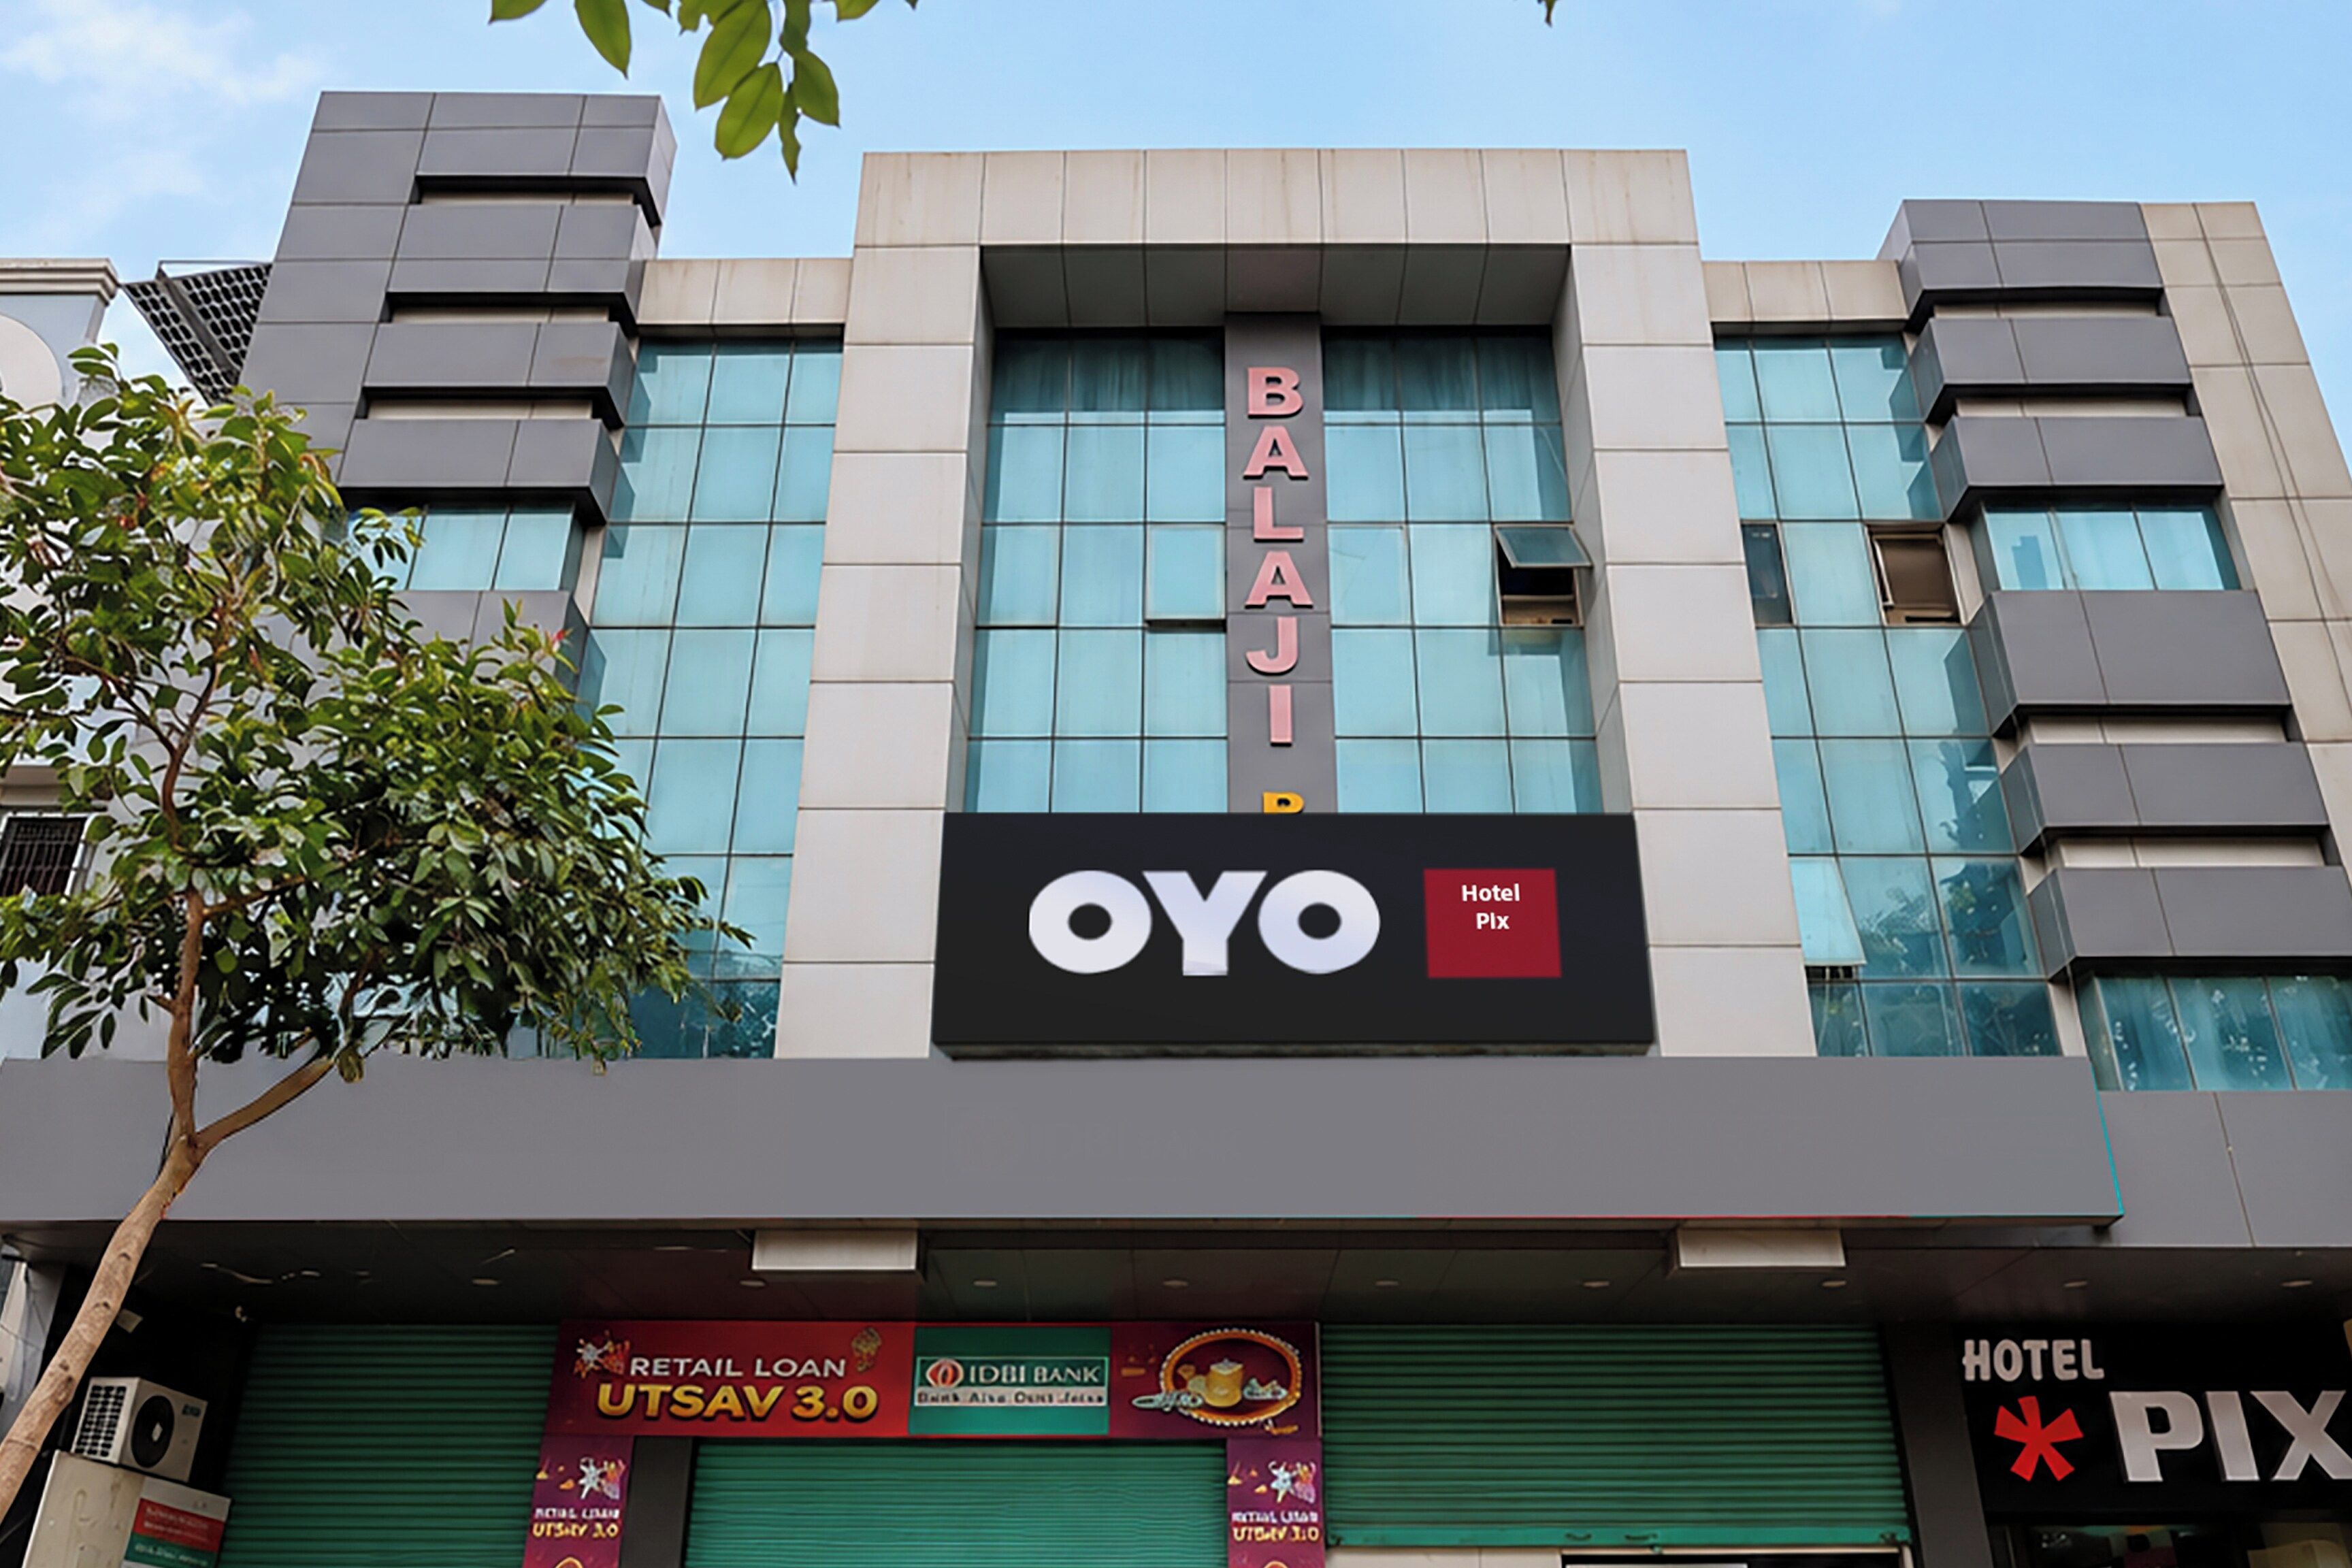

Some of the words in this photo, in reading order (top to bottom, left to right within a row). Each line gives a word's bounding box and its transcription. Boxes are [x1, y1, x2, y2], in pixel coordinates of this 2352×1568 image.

[1243, 367, 1313, 747] BALAJI
[1461, 883, 1520, 902] Hotel
[1028, 869, 1380, 976] OYO
[630, 1357, 743, 1377] RETAIL
[754, 1358, 846, 1378] LOAN
[969, 1365, 1026, 1384] IDBI
[1033, 1366, 1100, 1384] BANK
[1962, 1339, 2104, 1382] HOTEL
[596, 1383, 784, 1420] UTSAV
[791, 1385, 879, 1422] 3.0
[2109, 1390, 2352, 1482] PIX
